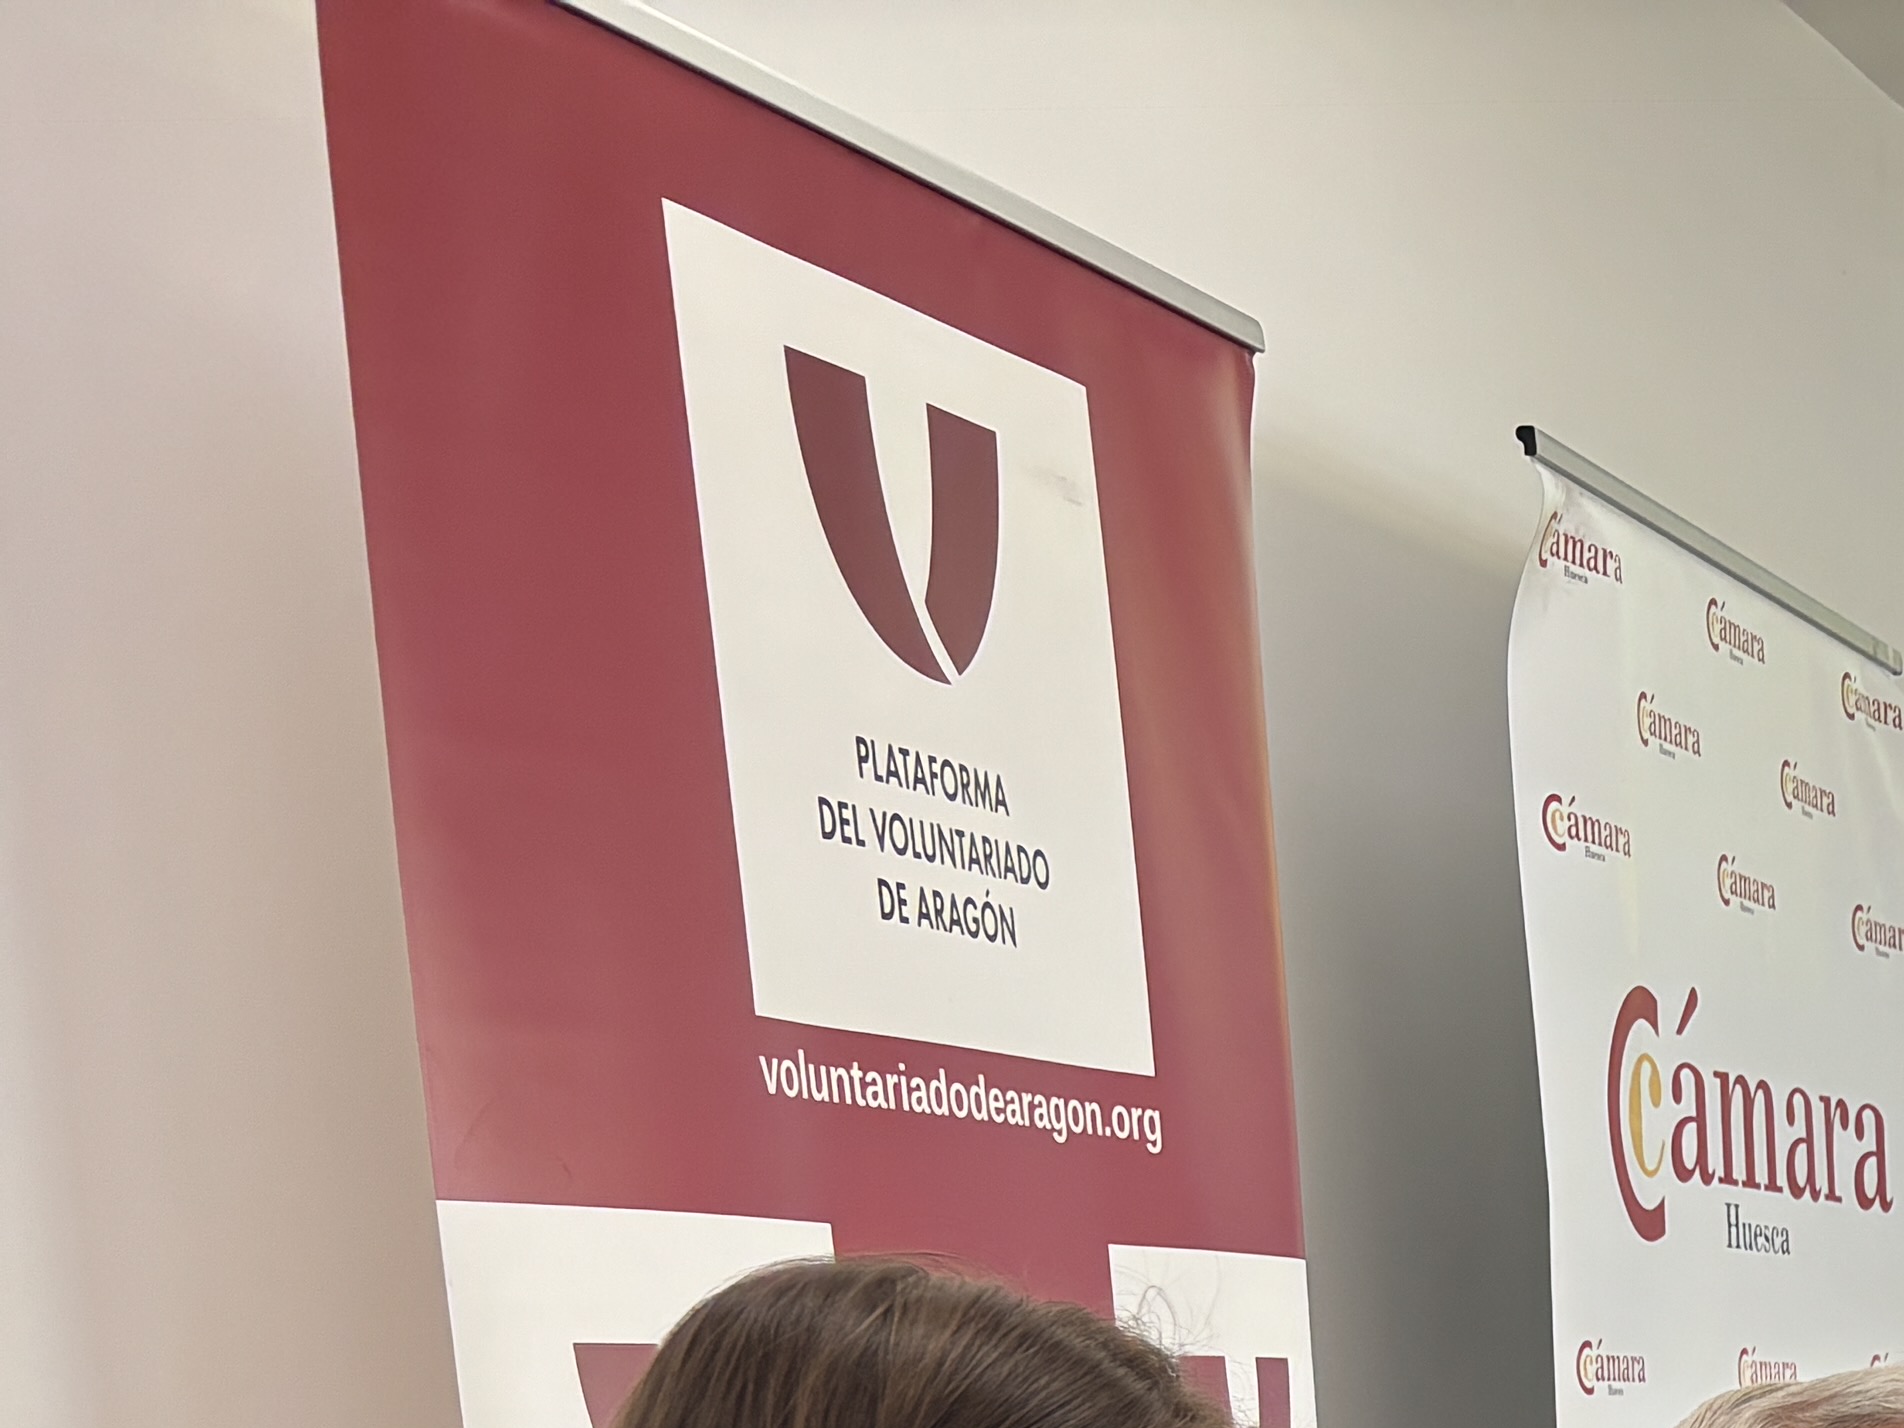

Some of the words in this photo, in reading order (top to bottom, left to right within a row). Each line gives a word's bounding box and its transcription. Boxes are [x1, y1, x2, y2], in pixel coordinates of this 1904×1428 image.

[855, 735, 1010, 817] PLATAFORMA
[817, 795, 867, 848] DEL
[869, 806, 1050, 891] VOLUNTARIADO
[877, 876, 911, 924] DE
[916, 889, 1018, 948] ARAGÓN
[759, 1049, 1164, 1155] voluntariadodearagon.org
[1725, 1202, 1792, 1257] Huesca
